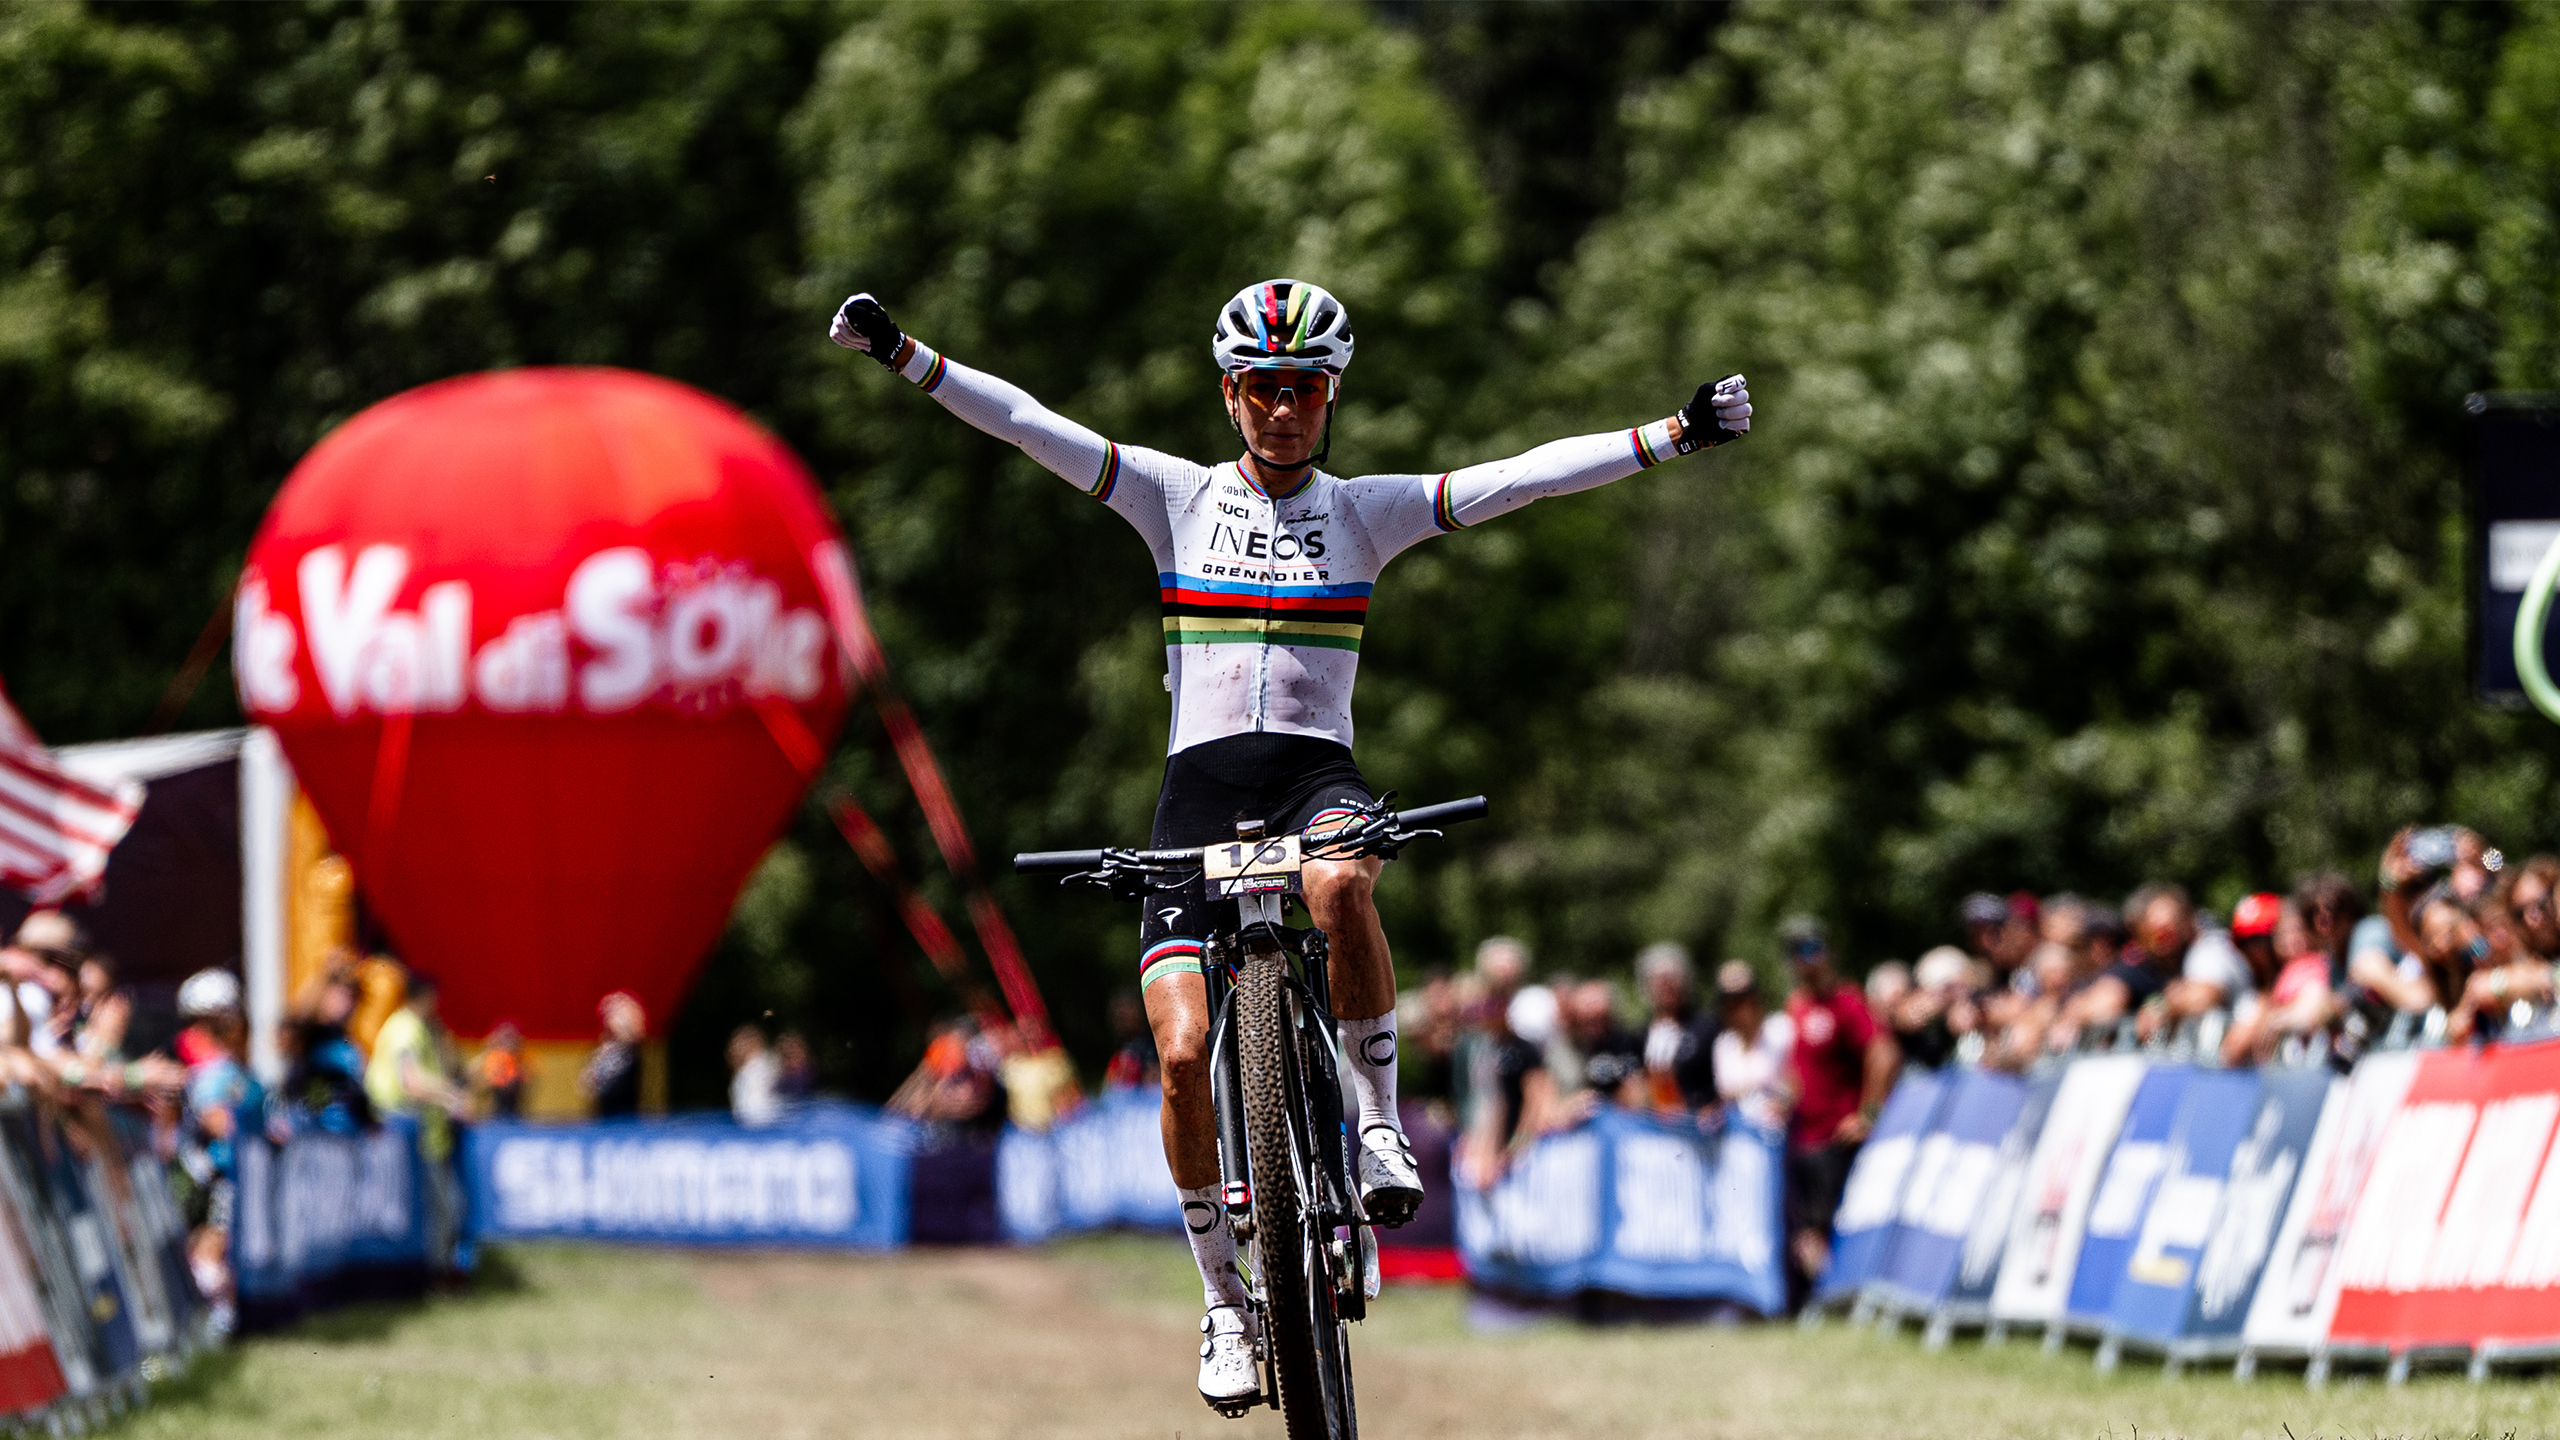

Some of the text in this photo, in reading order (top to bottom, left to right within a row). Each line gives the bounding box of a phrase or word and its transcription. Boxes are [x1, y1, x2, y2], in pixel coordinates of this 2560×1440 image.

[1223, 503, 1249, 520] UCI
[1208, 522, 1326, 560] INEOS
[1202, 563, 1329, 582] GRENADIER
[296, 543, 474, 720] Val
[1221, 840, 1287, 868] 16
